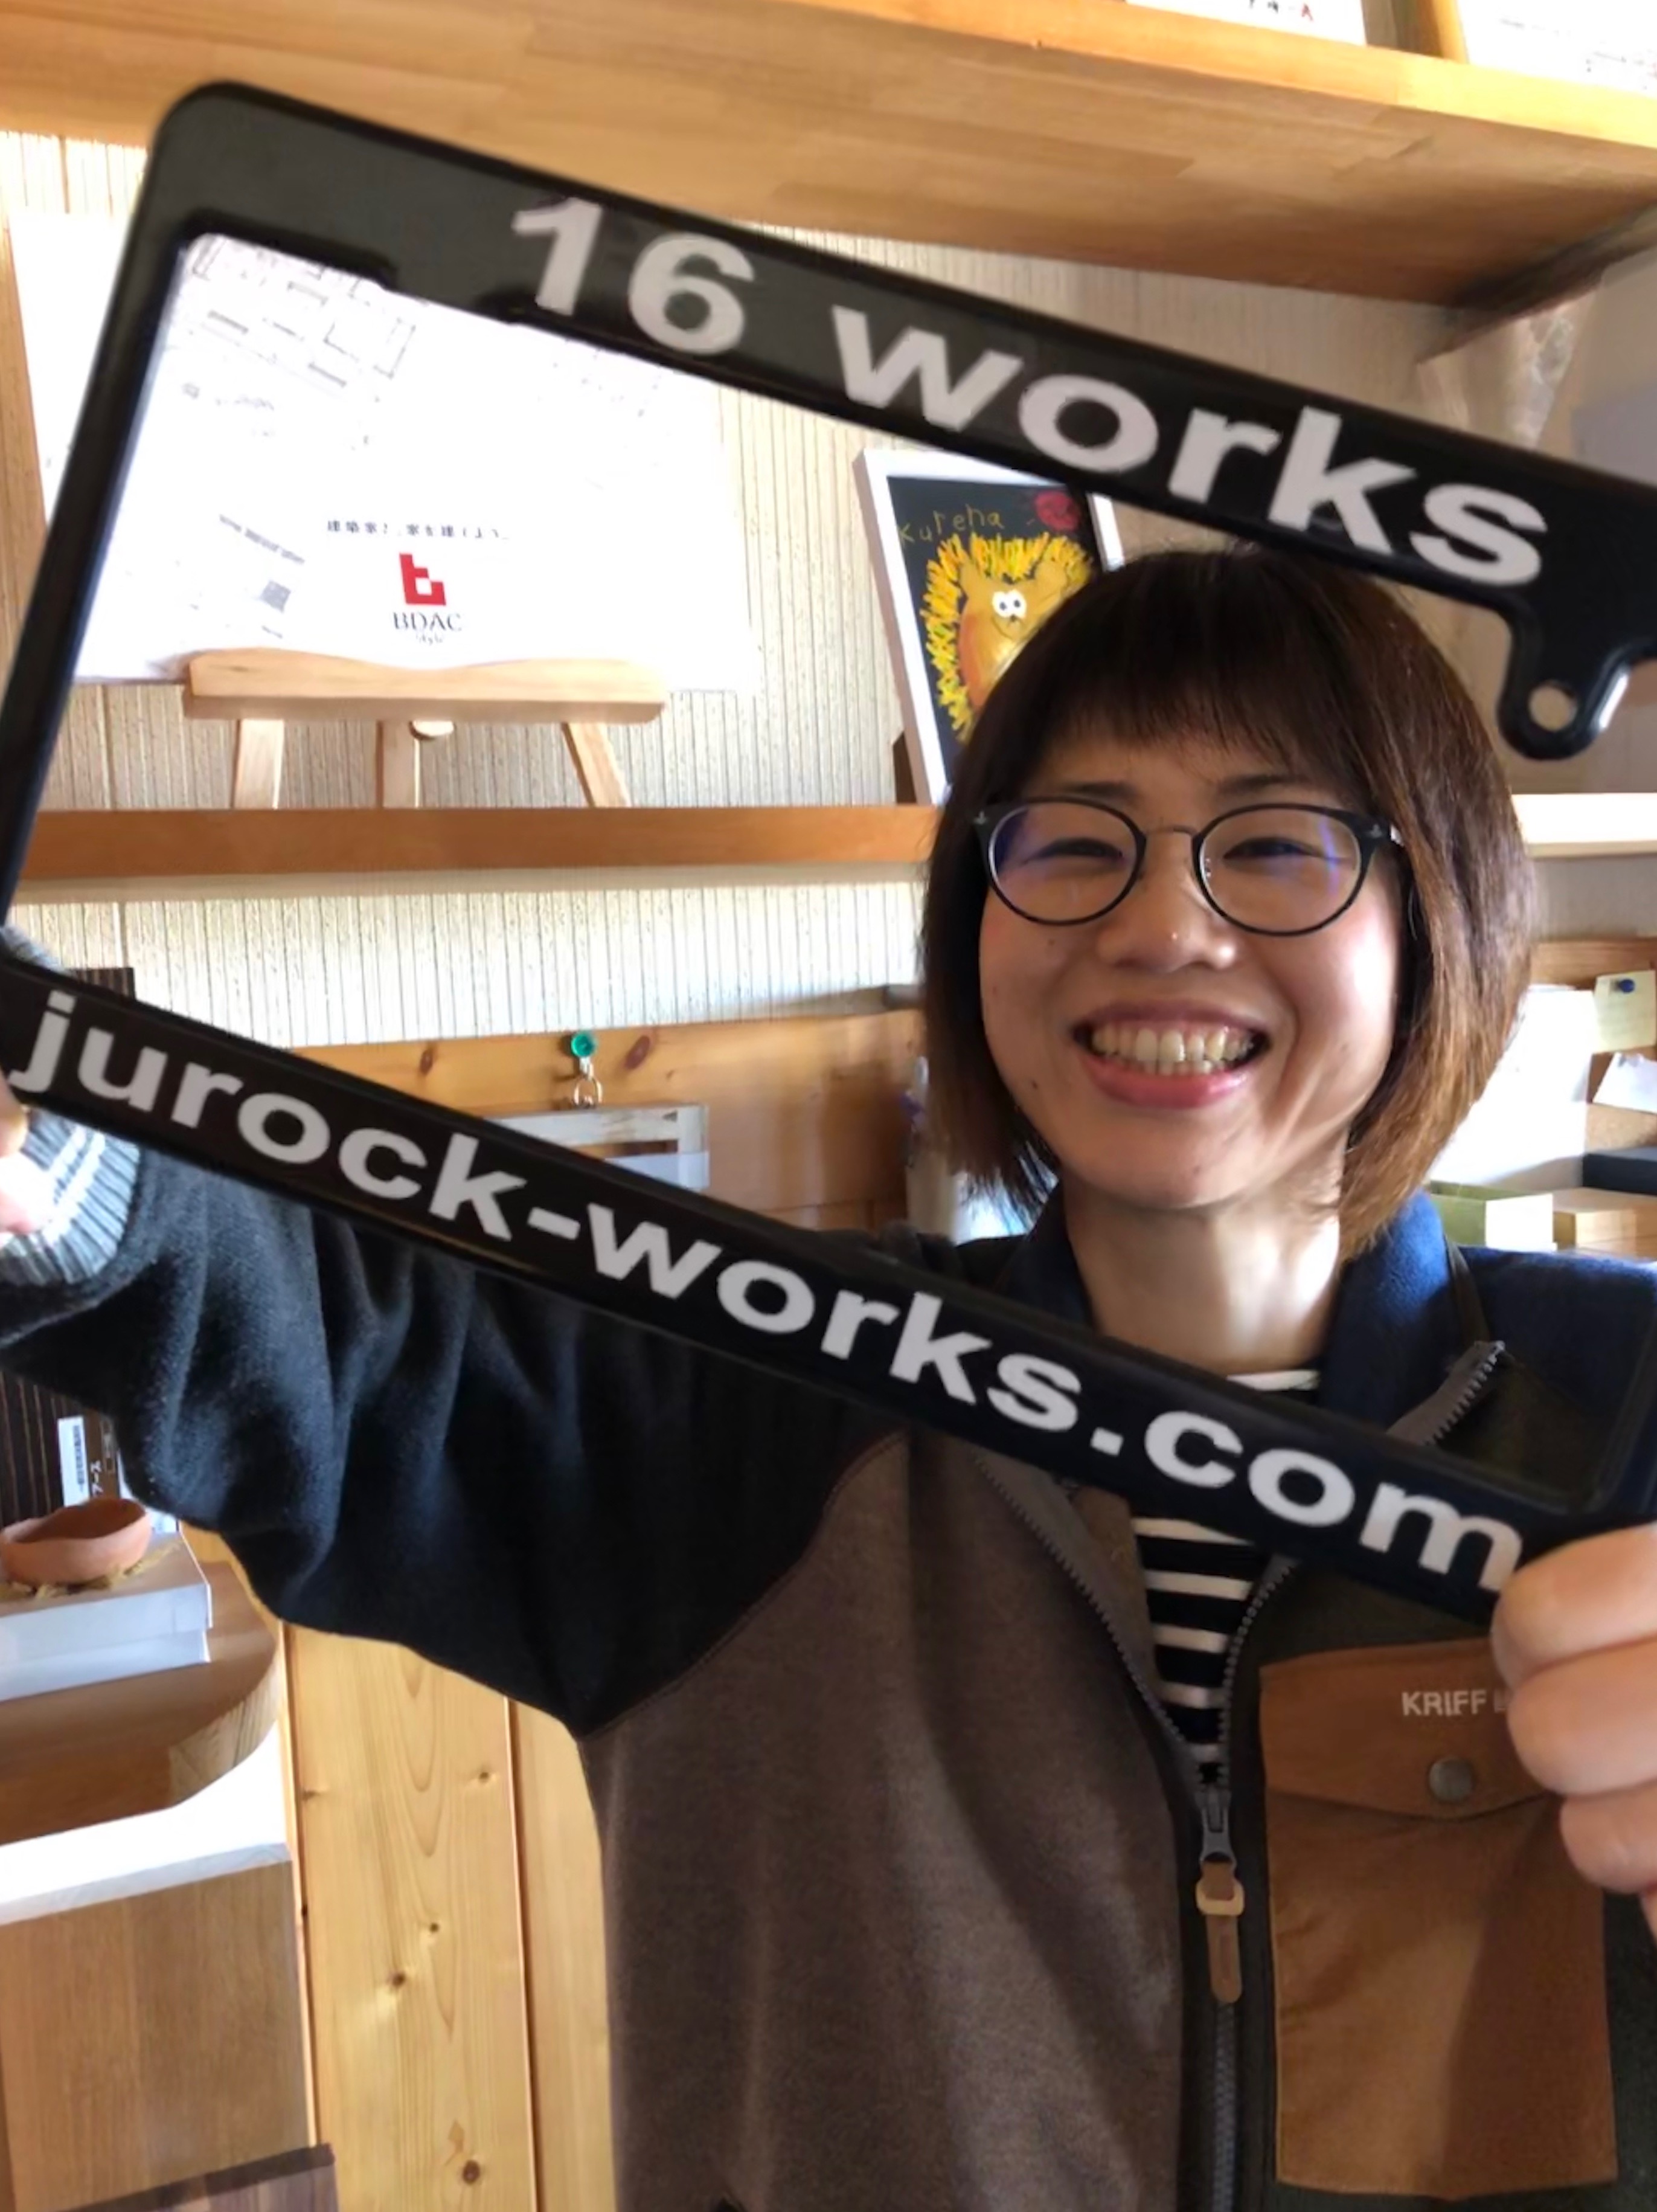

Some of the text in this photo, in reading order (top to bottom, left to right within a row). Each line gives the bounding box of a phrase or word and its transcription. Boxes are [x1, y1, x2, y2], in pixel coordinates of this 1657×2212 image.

[511, 197, 1547, 586] 16 works
[393, 611, 462, 631] BDAC
[7, 989, 1523, 1591] jurock-works.com
[1402, 1689, 1487, 1717] KRIFF
